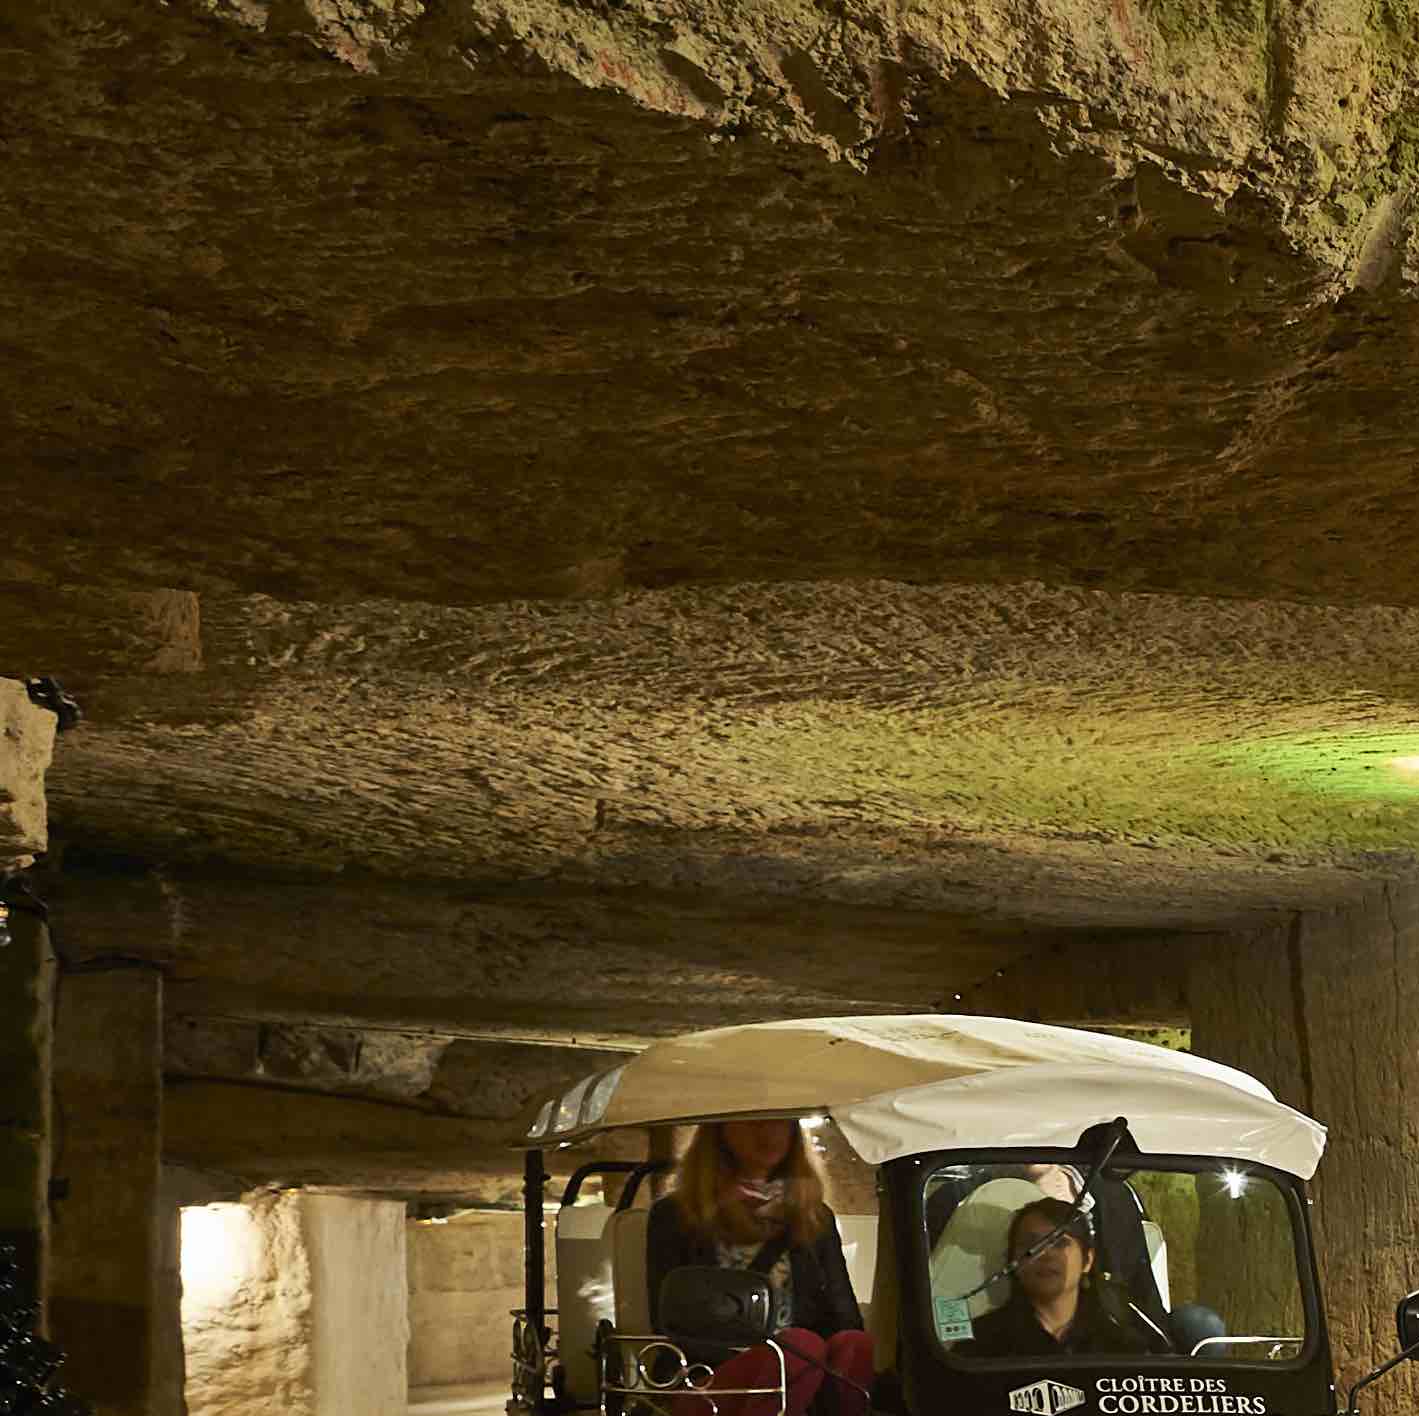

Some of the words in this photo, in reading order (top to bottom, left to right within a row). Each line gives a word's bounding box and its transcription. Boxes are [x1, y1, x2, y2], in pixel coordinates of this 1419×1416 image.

[1095, 1375, 1184, 1393] CLOÎTRE
[1190, 1378, 1227, 1393] DES
[1098, 1395, 1266, 1415] CORDELIERS
